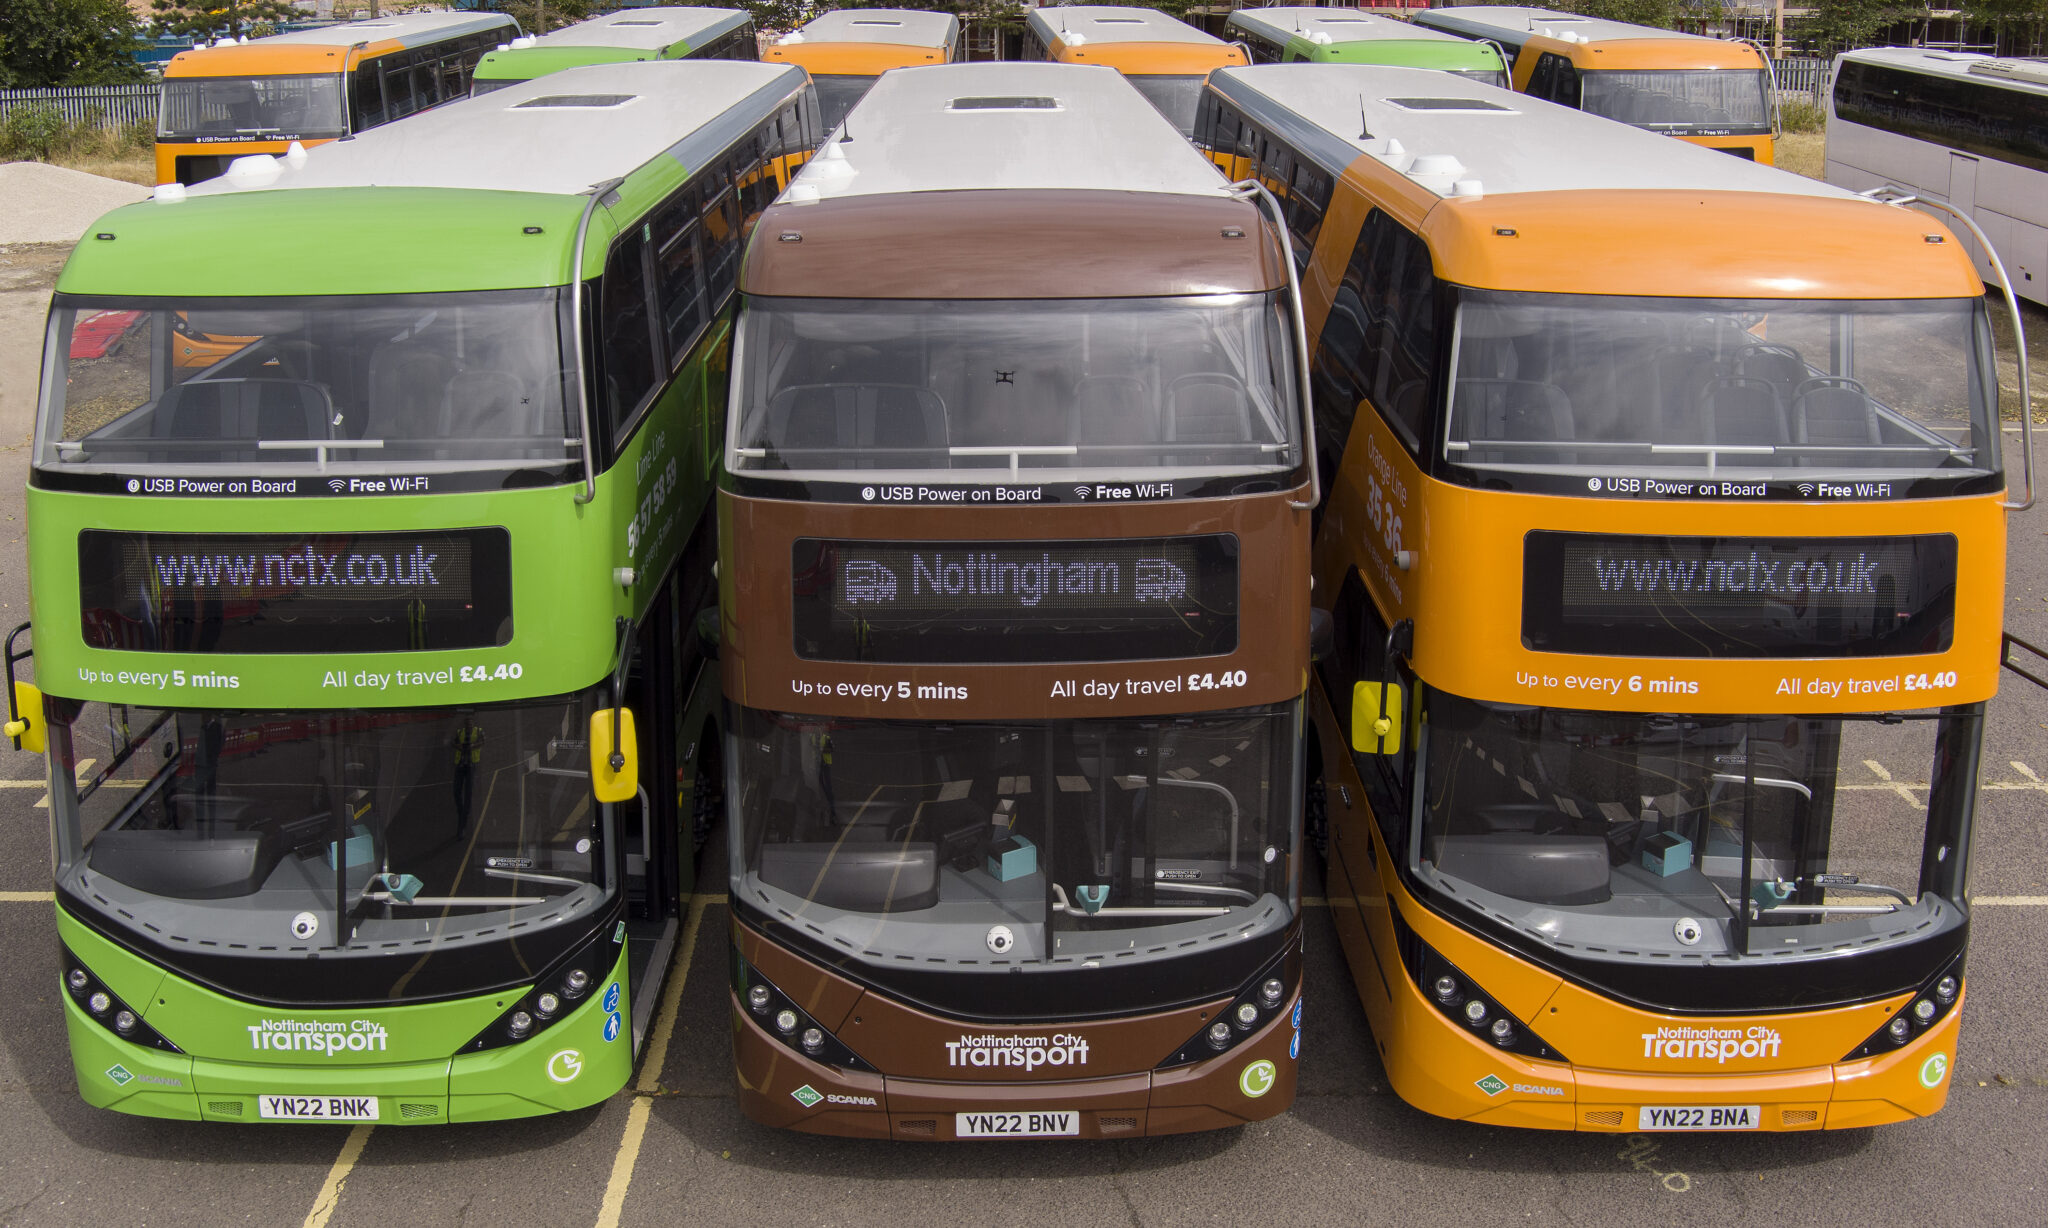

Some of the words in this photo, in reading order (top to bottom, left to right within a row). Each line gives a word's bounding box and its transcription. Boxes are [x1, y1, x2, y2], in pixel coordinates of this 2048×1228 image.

[636, 450, 651, 486] Lime
[652, 431, 665, 462] Line
[1368, 434, 1391, 486] Orange
[1391, 466, 1407, 508] Line
[144, 480, 175, 493] USB
[178, 480, 224, 493] Power
[228, 483, 247, 493] on
[251, 479, 297, 493] Board
[350, 479, 386, 492] Free
[390, 477, 429, 491] Wi-Fi
[880, 487, 914, 500] USB
[918, 488, 967, 501] Power
[971, 490, 991, 501] on
[995, 486, 1041, 501] Board
[1096, 486, 1132, 498] Free
[1136, 484, 1174, 498] Wi-Fi
[1607, 479, 1641, 492] USB
[1645, 481, 1694, 495] Power
[1699, 484, 1718, 496] on
[1721, 483, 1766, 496] Board
[1818, 484, 1852, 497] Free
[1855, 484, 1891, 497] Wi-Fi
[627, 513, 640, 558] 56
[640, 492, 651, 535] 57
[653, 474, 665, 514] 58
[666, 456, 677, 494] 59
[1366, 474, 1383, 532] 35
[1384, 502, 1402, 556] 36
[156, 545, 440, 586] www.nctx.co.uk
[1596, 552, 1878, 593] www.nctx.co.uk
[912, 553, 1120, 606] Nottingham
[78, 667, 97, 684] Up
[100, 671, 114, 683] to
[117, 671, 169, 690] every
[172, 669, 186, 687] 5
[190, 670, 240, 688] mins
[322, 669, 347, 688] All
[353, 669, 391, 691] day
[395, 666, 454, 686] travel
[459, 662, 524, 683] £4.40
[1050, 679, 1076, 698] All
[1082, 679, 1121, 700] day
[1126, 675, 1182, 695] travel
[1188, 669, 1248, 692] £4.40
[1516, 671, 1539, 689] Up
[1542, 674, 1559, 688] to
[1564, 675, 1623, 695] every
[1628, 675, 1643, 693] 6
[1648, 675, 1700, 694] mins
[1775, 677, 1802, 695] All
[1807, 677, 1844, 698] day
[1847, 675, 1900, 694] travel
[1904, 670, 1958, 691] £4.40
[792, 679, 813, 697] Up
[816, 682, 831, 695] to
[836, 682, 894, 702] every
[897, 681, 912, 699] 5
[917, 681, 969, 700] mins
[262, 1019, 347, 1036] Nottingham
[350, 1019, 380, 1035] City
[1657, 1026, 1742, 1042] Nottingham
[1746, 1026, 1775, 1041] City
[247, 1025, 388, 1057] Transport
[960, 1034, 1048, 1050] Nottingham
[1052, 1033, 1082, 1049] City
[1641, 1032, 1782, 1064] Transport
[945, 1040, 1089, 1072] Transport
[112, 1070, 129, 1080] CNG
[137, 1074, 183, 1087] SCANIA
[1482, 1080, 1501, 1090] CNG
[1512, 1083, 1564, 1096] SCANIA
[798, 1091, 817, 1101] CNG
[827, 1094, 877, 1106] SCANIA
[269, 1098, 325, 1117] YN22
[329, 1099, 371, 1117] BNK
[966, 1114, 1022, 1134] YN22
[1028, 1114, 1070, 1132] BNV
[1650, 1109, 1704, 1127] YN22
[1710, 1109, 1750, 1126] BNA
